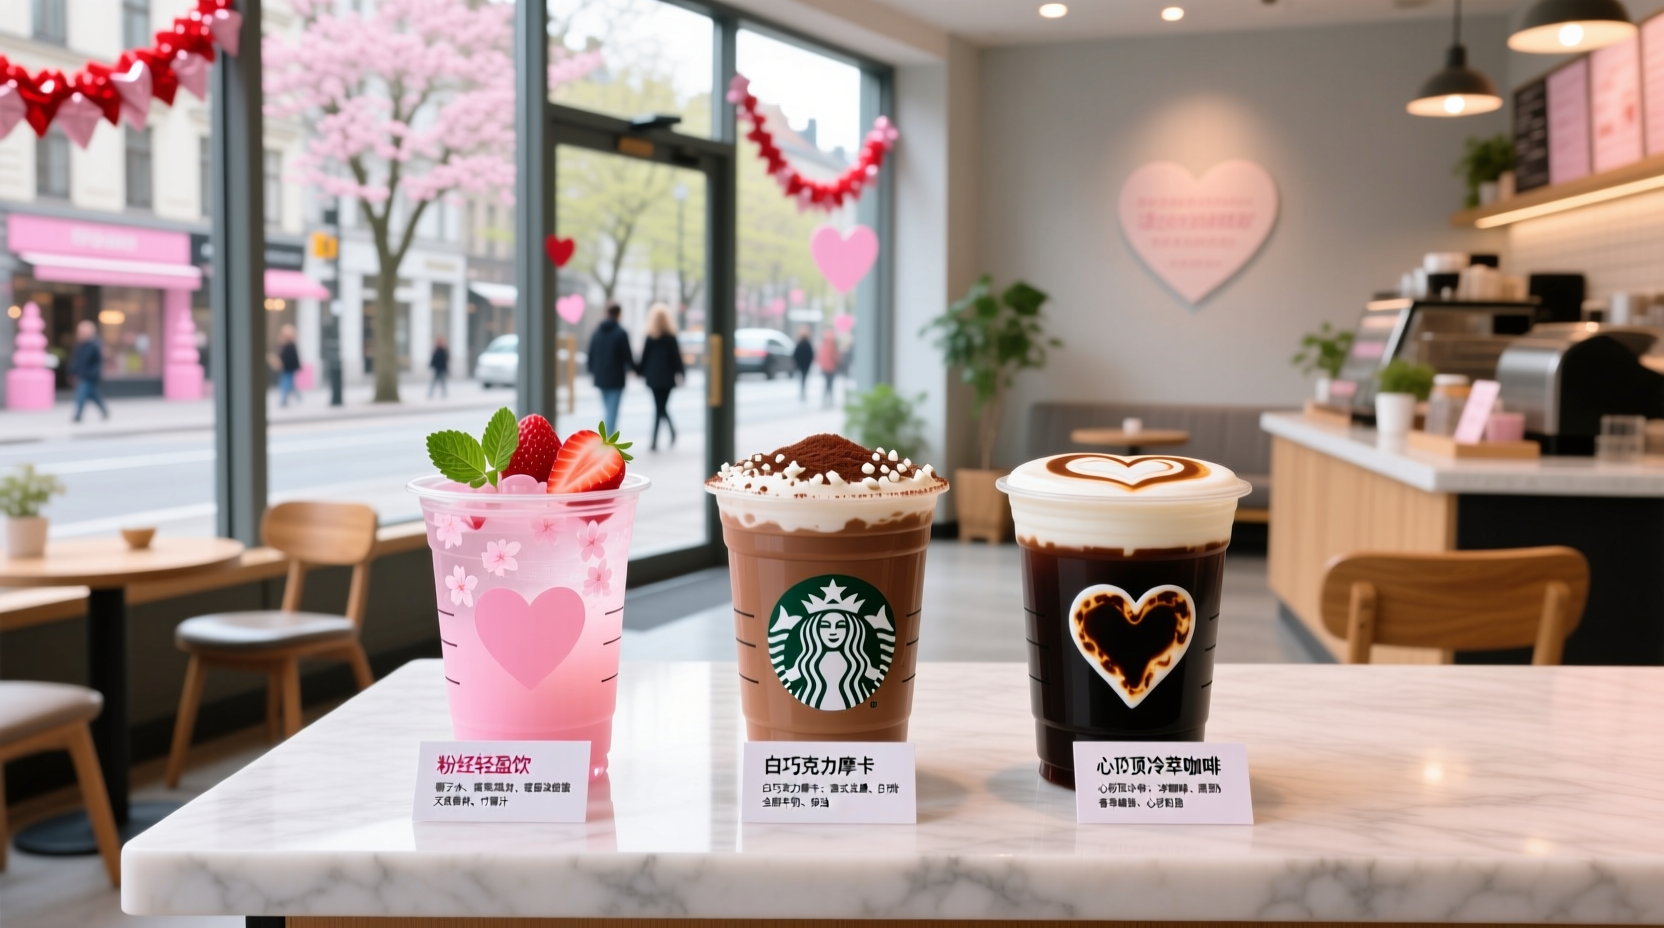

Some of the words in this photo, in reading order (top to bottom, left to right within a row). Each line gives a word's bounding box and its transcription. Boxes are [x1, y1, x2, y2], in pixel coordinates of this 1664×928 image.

[765, 754, 874, 776] 白巧克力摩卡
